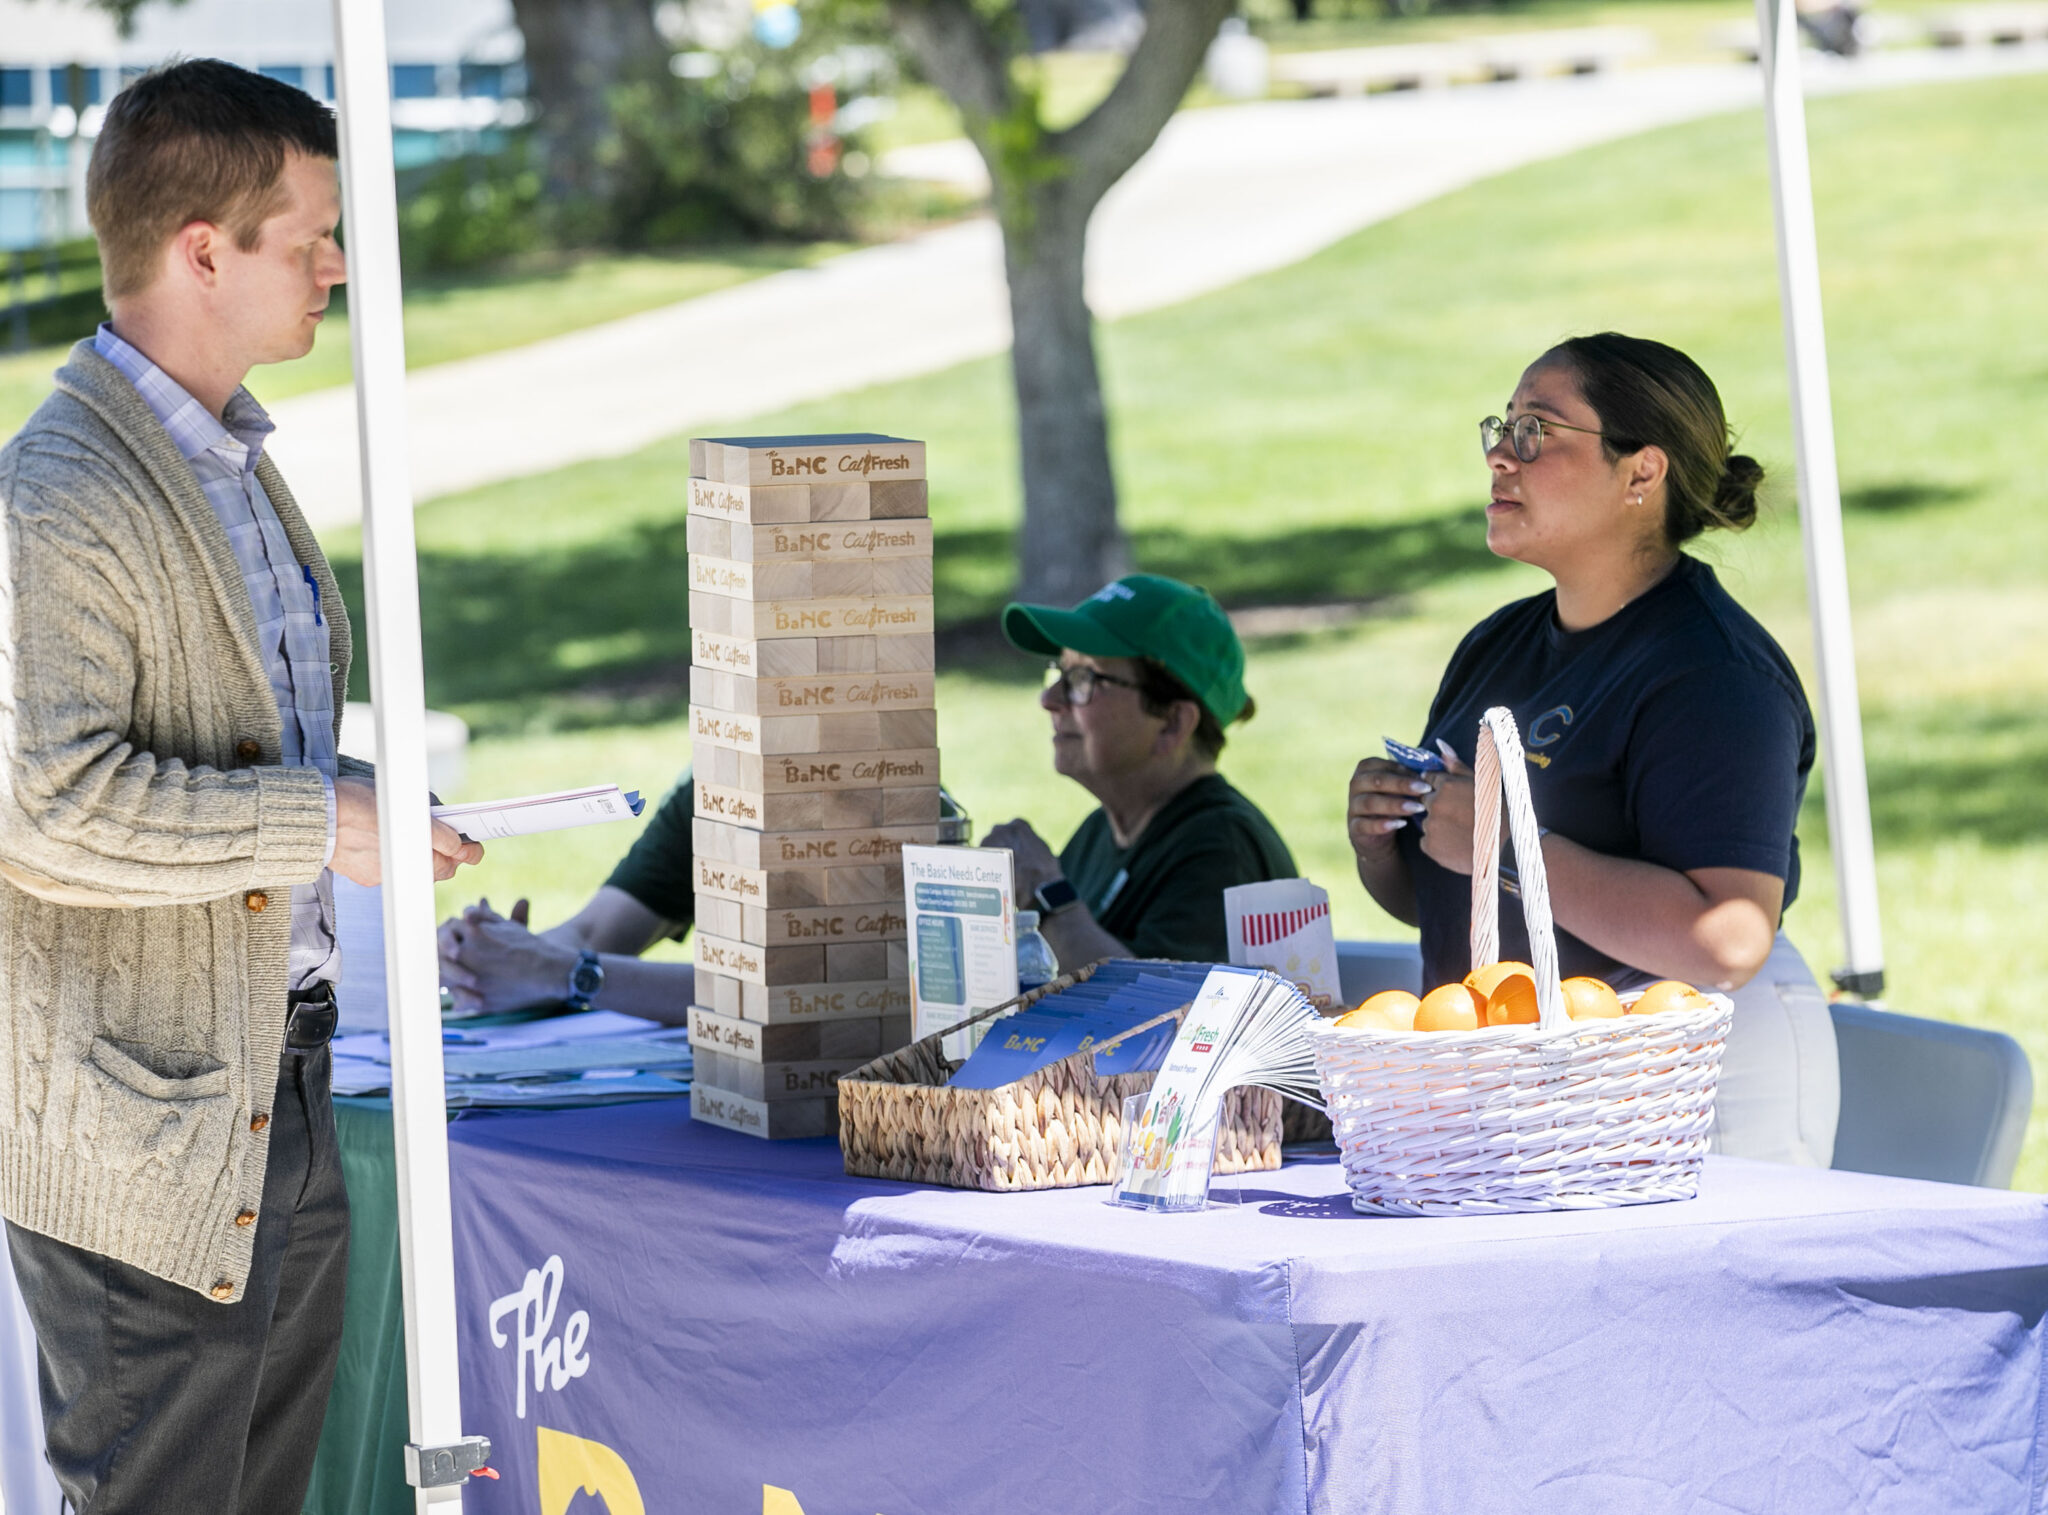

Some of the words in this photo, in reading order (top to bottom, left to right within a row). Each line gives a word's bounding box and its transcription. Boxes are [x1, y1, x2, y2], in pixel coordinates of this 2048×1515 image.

[771, 456, 827, 476] BaNC
[838, 450, 909, 477] CalFresh
[774, 533, 831, 552] BaNC
[842, 527, 915, 554] CalFresh
[775, 611, 832, 630] BaNC
[843, 605, 916, 629] CalFresh
[779, 687, 835, 706] BaNC
[846, 680, 918, 705] CalFresh
[698, 717, 720, 737] BaNC
[1527, 705, 1573, 747] C
[785, 764, 841, 783] BaNC
[853, 759, 924, 783] CalFresh
[702, 792, 724, 813] BaNC
[782, 840, 838, 860] BaNC
[848, 835, 919, 860] CalFre
[702, 868, 725, 889] BaNC
[911, 862, 925, 877] The
[927, 863, 947, 880] Basic
[948, 865, 973, 881] Needs
[975, 867, 1002, 883] Center
[788, 918, 844, 938] BaNC
[702, 945, 724, 966] BaNC
[789, 994, 845, 1014] BaNC
[696, 1019, 719, 1042] BaNC
[1003, 1034, 1046, 1052] BaNC
[785, 1069, 841, 1091] BaNC
[489, 1254, 590, 1419] The
